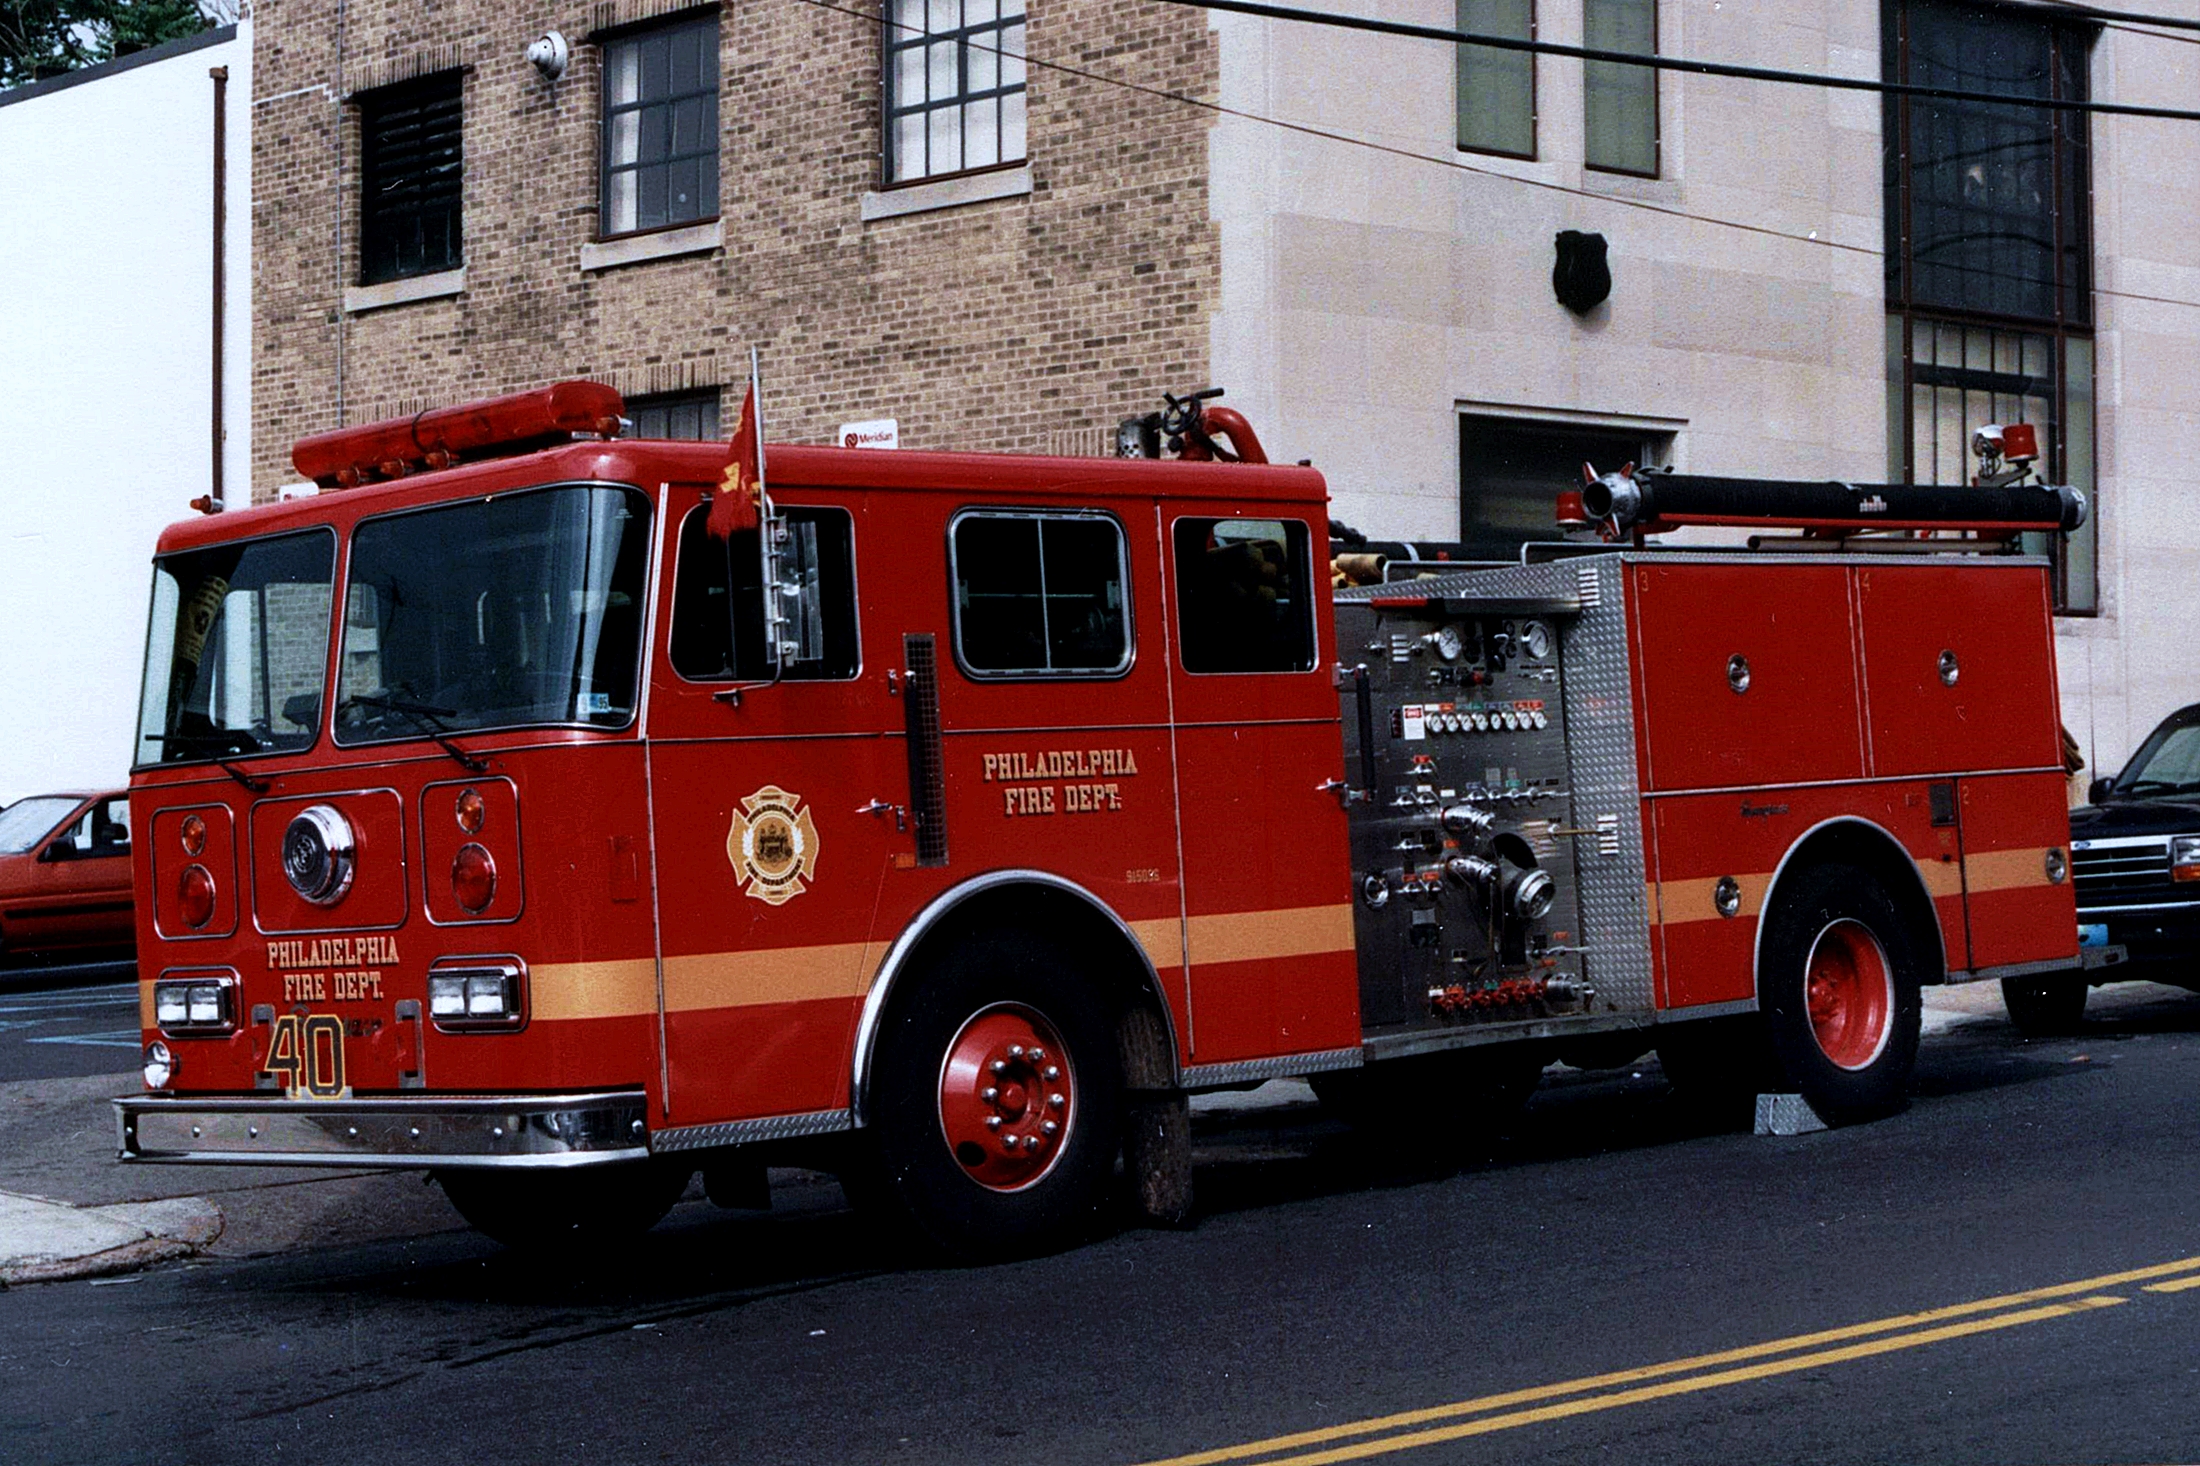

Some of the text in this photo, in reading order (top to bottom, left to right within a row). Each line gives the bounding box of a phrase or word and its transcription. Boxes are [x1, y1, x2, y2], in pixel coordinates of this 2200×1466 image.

[983, 749, 1138, 780] PHILADELPHIA
[1005, 783, 1122, 815] FIRE DEPT.
[267, 936, 399, 969] PHILADELPHIA
[284, 971, 384, 1001] FIRE DEPT.
[264, 1014, 346, 1099] 40
